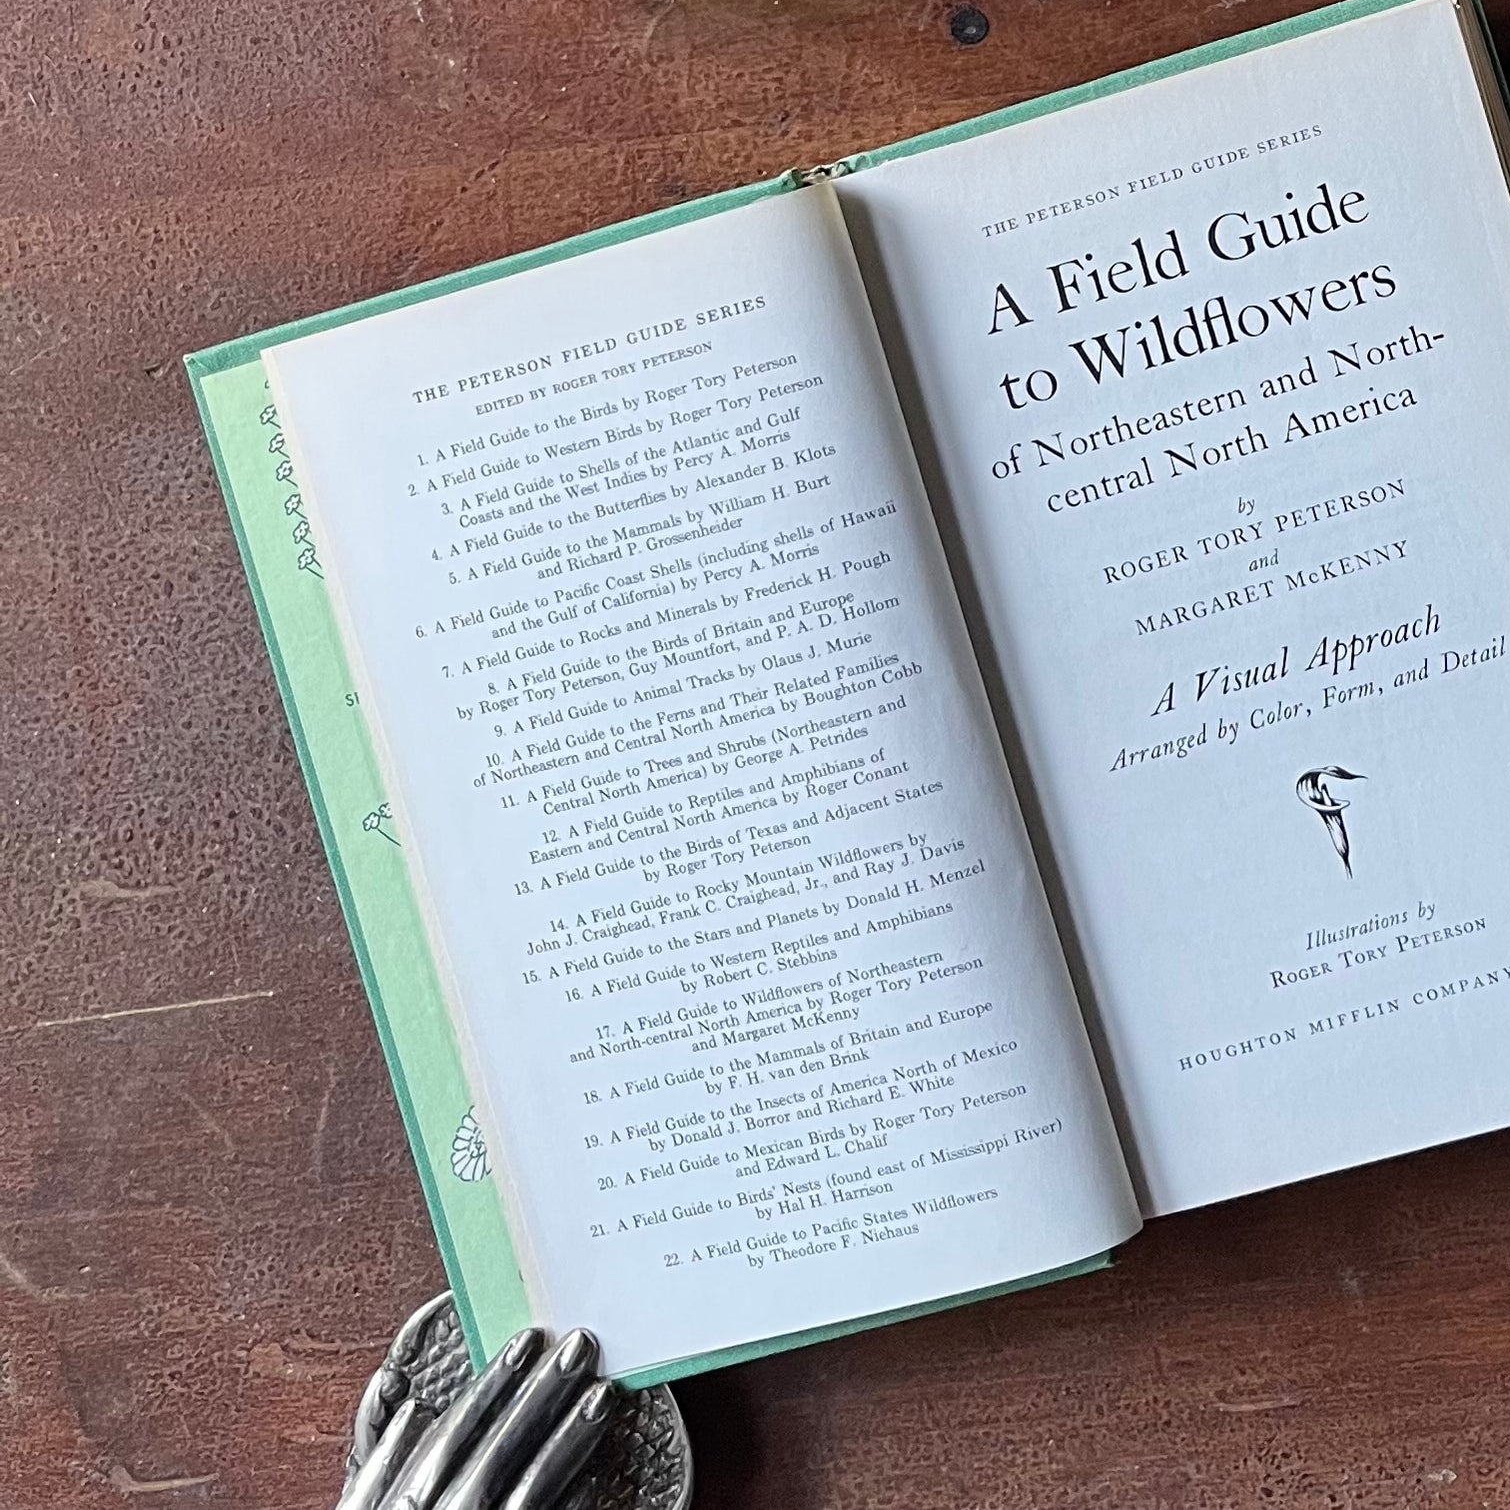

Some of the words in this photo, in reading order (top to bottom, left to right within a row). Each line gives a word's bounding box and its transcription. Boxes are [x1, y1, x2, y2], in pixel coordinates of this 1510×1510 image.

[987, 283, 1035, 336] A
[1046, 229, 1190, 314] Field
[1207, 182, 1370, 261] Guide
[412, 384, 450, 404] THE
[457, 354, 552, 393] PETERSON
[561, 337, 617, 364] FIELD
[626, 317, 687, 345] GUIDE
[695, 295, 766, 326] SERIES
[999, 369, 1058, 410] to
[1068, 265, 1396, 385] Wildflowers
[436, 448, 447, 463] A
[449, 435, 486, 458] Field
[489, 426, 530, 447] Guide
[533, 422, 549, 435] to
[553, 414, 577, 430] the
[579, 401, 619, 422] Birds
[621, 396, 640, 412] by
[644, 384, 688, 405] Roger
[691, 374, 727, 391] Tory
[731, 354, 798, 380] Peterson
[991, 443, 1022, 479] of
[1031, 389, 1247, 468] Northeastern
[1259, 355, 1319, 399] and
[1326, 325, 1445, 378] North-
[1102, 545, 1189, 585] ROGER
[1196, 520, 1263, 555] TORY
[1274, 478, 1405, 533] PETERSON
[1134, 579, 1274, 636] MARGARET
[1284, 539, 1407, 592] McKENNY
[1150, 681, 1175, 717] A
[1195, 645, 1289, 702] Visual
[1304, 603, 1441, 676] Approach
[1178, 1027, 1296, 1072] HOUGHTON
[1308, 998, 1399, 1036] MIFFLIN
[754, 1206, 772, 1221] by
[777, 1196, 806, 1215] Hal
[830, 1182, 894, 1204] Harrison
